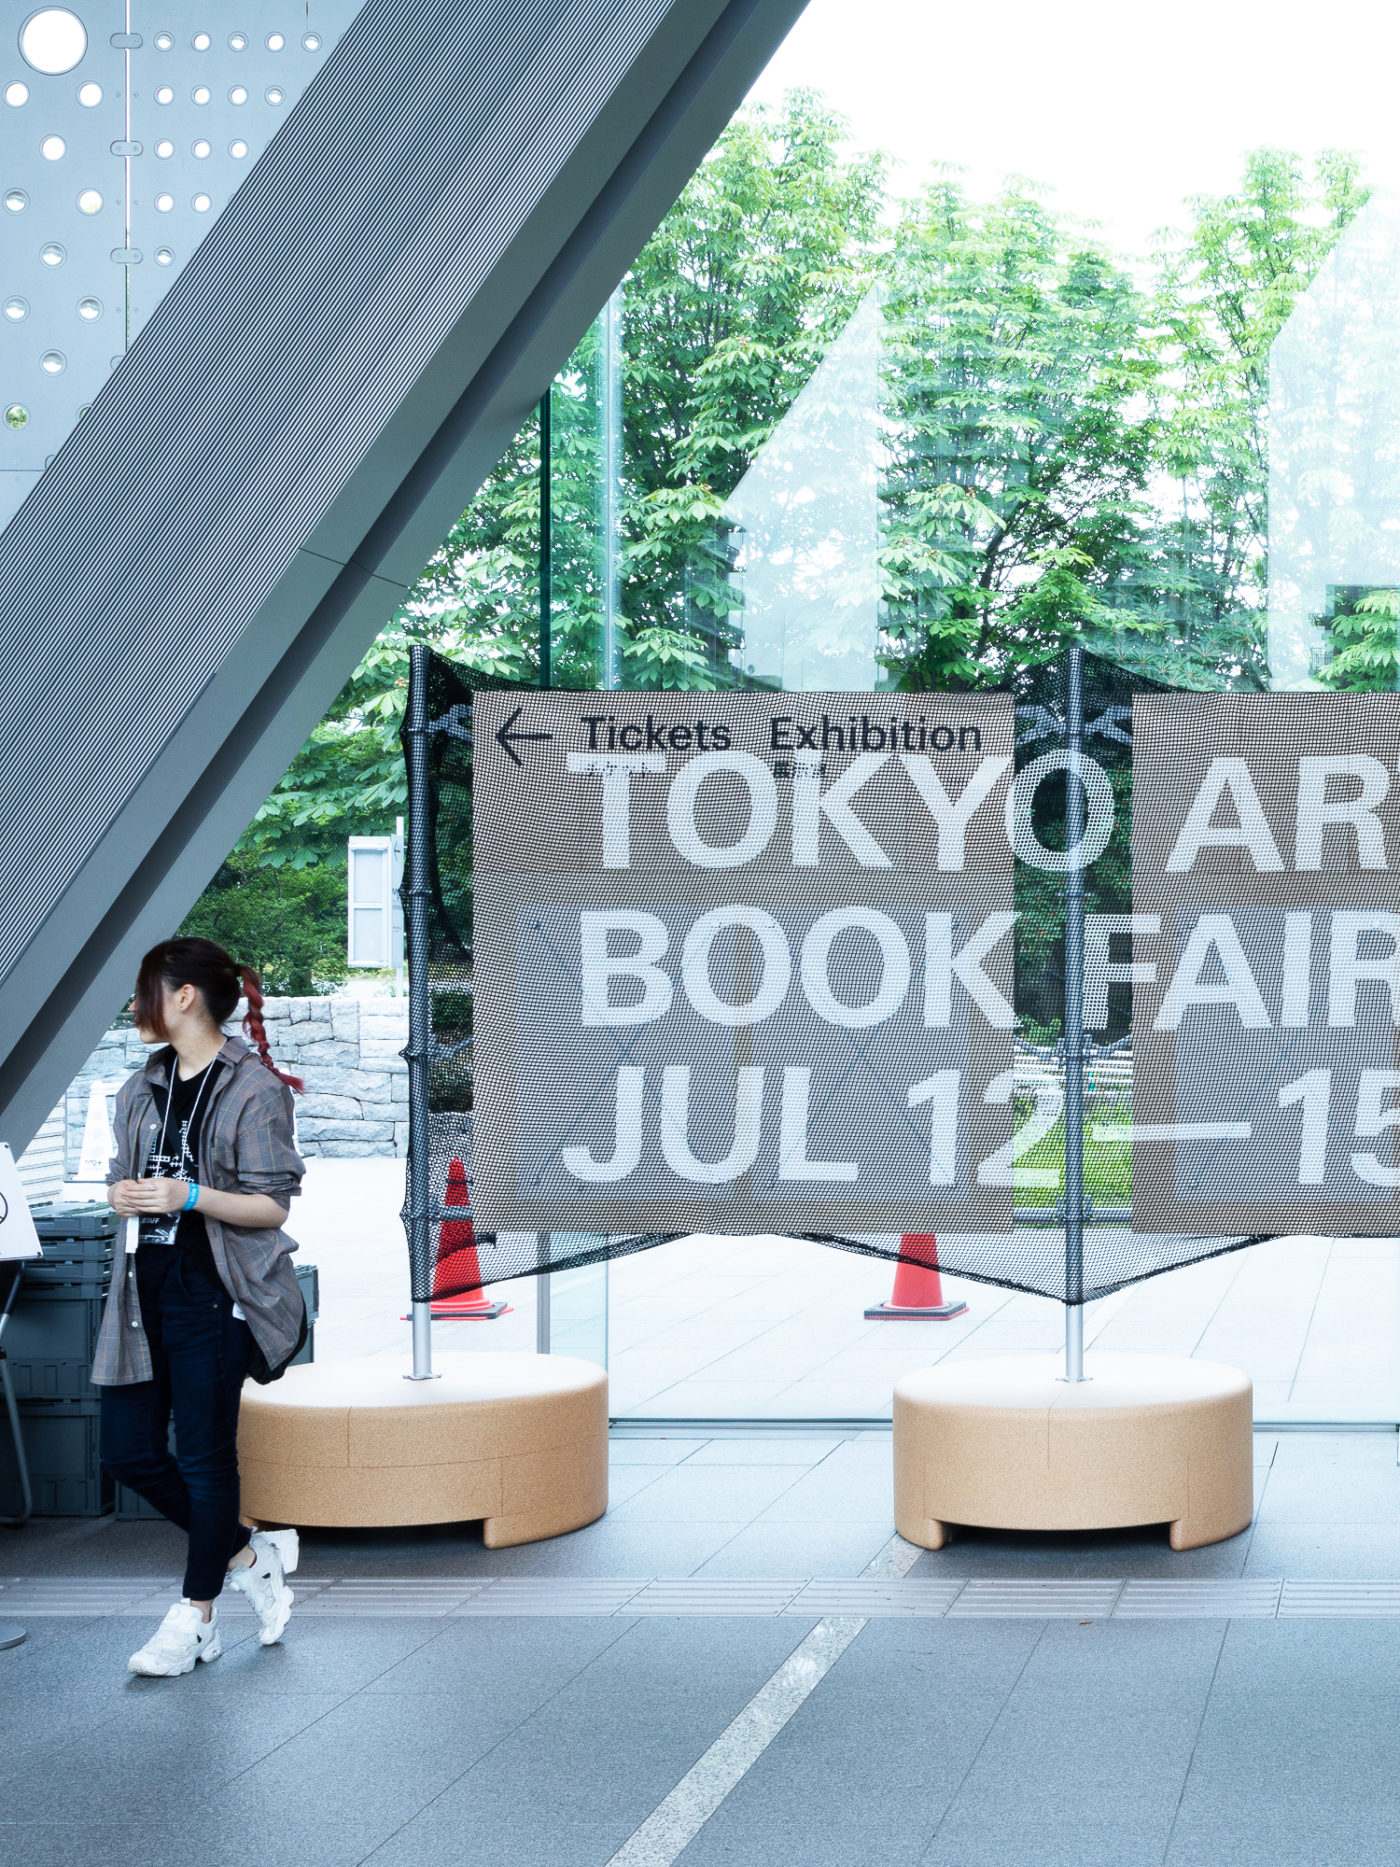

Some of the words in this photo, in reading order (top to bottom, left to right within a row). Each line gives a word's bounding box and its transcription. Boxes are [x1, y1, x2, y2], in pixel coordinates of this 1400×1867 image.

[582, 715, 732, 750] Tickets
[771, 715, 982, 750] Exhibition
[566, 748, 1115, 871] TOKYO
[580, 905, 1023, 1030] BOOK
[562, 1065, 859, 1184] JUL
